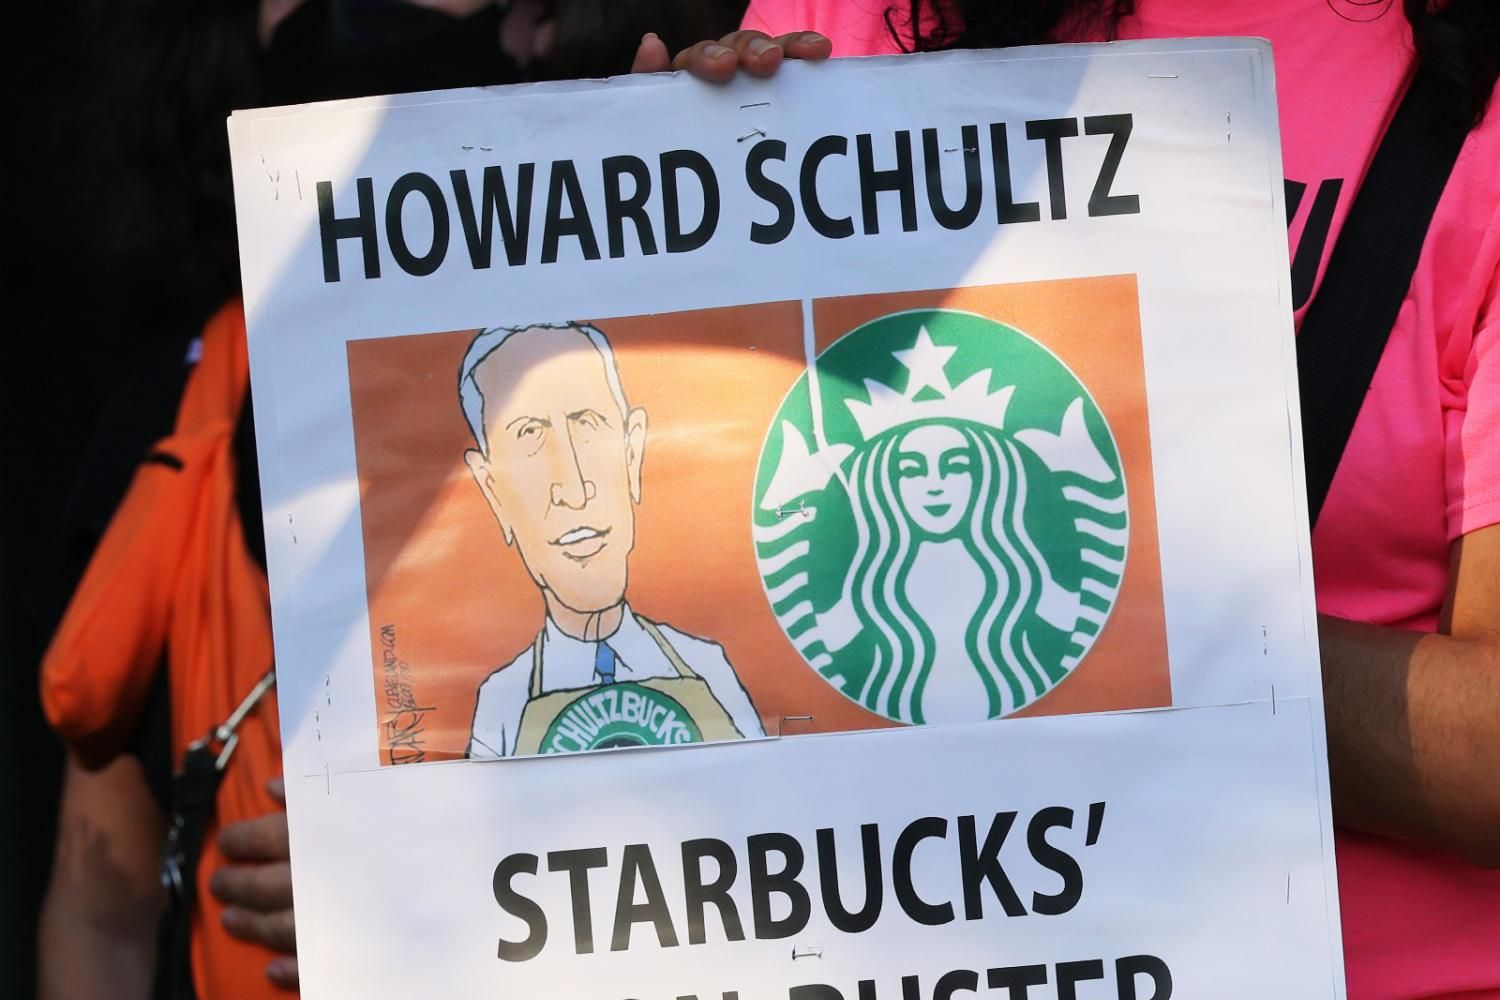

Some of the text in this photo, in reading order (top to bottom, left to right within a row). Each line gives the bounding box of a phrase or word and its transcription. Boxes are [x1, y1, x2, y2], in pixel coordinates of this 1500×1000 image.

[316, 148, 722, 284] HOWARD
[744, 112, 1141, 246] SCHULTZ
[546, 689, 692, 754] CHULTZBUCKS
